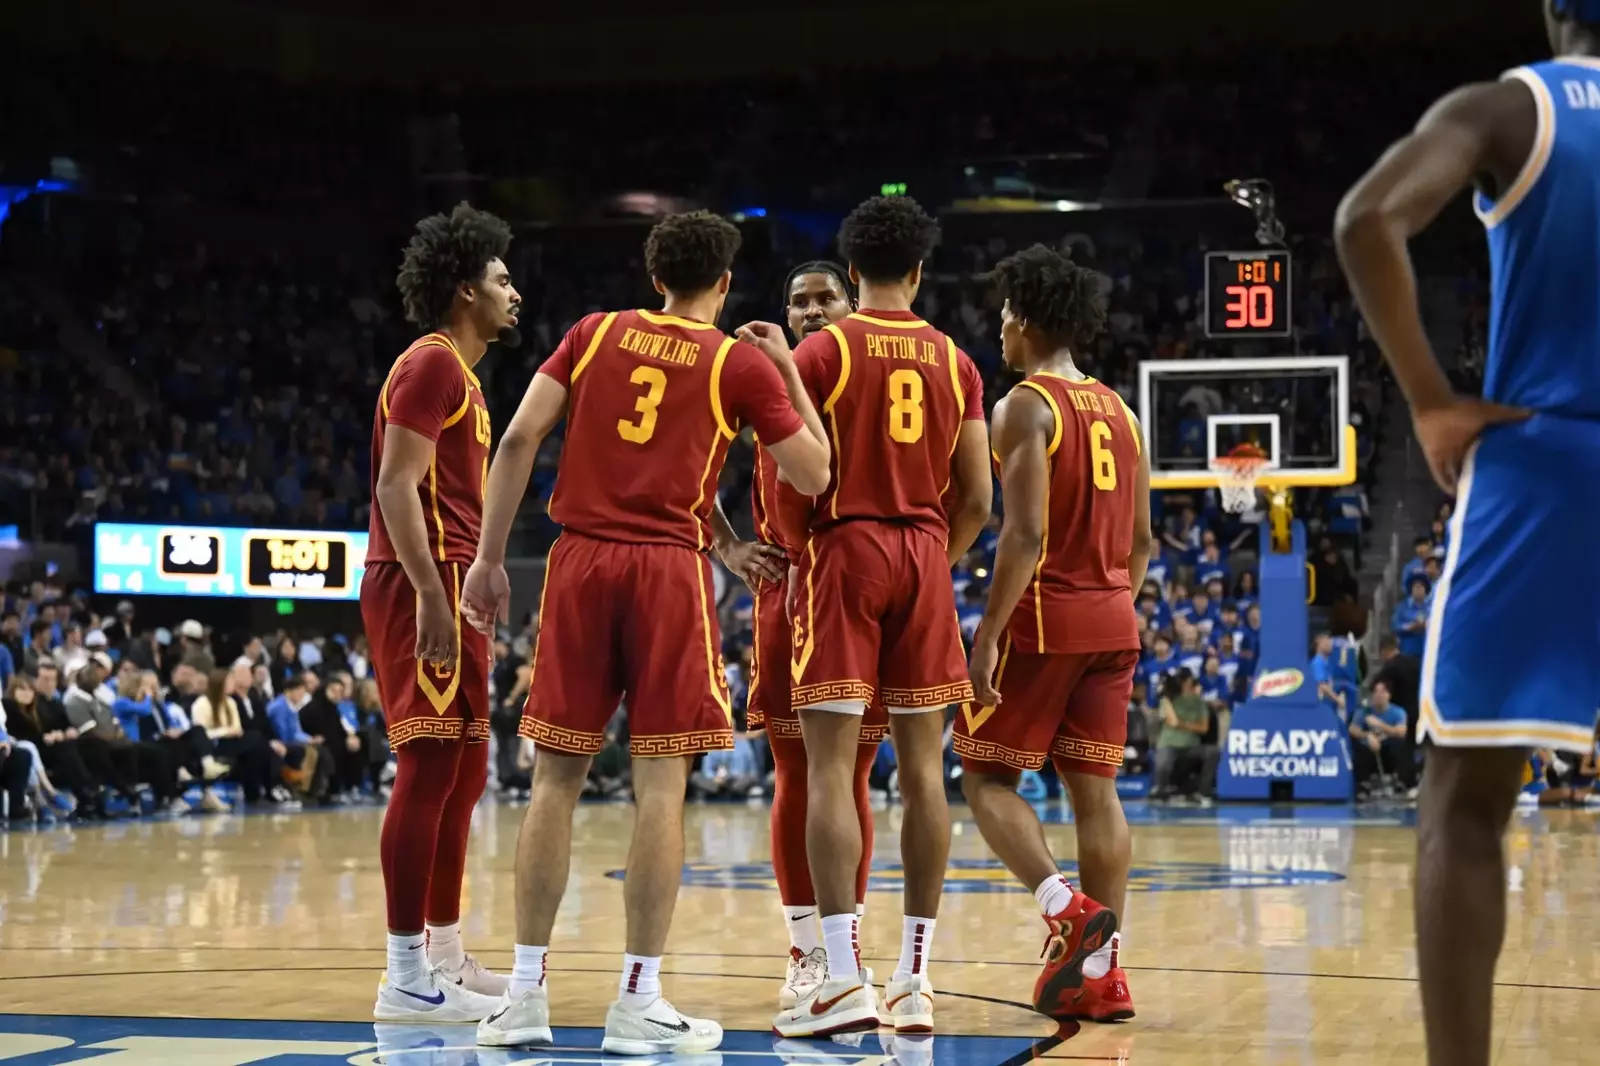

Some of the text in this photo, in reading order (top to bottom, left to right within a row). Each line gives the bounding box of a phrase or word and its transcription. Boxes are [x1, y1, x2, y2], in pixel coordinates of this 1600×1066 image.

[1238, 261, 1280, 282] 1:01
[1226, 286, 1273, 327] 30
[618, 327, 701, 367] KNOWLING
[865, 333, 917, 360] PATTON
[616, 365, 668, 445] 3
[888, 369, 924, 444] 8
[1090, 420, 1117, 491] 6
[267, 538, 329, 570] 1:01
[1228, 729, 1329, 756] READY
[1228, 756, 1316, 777] WESCOM
